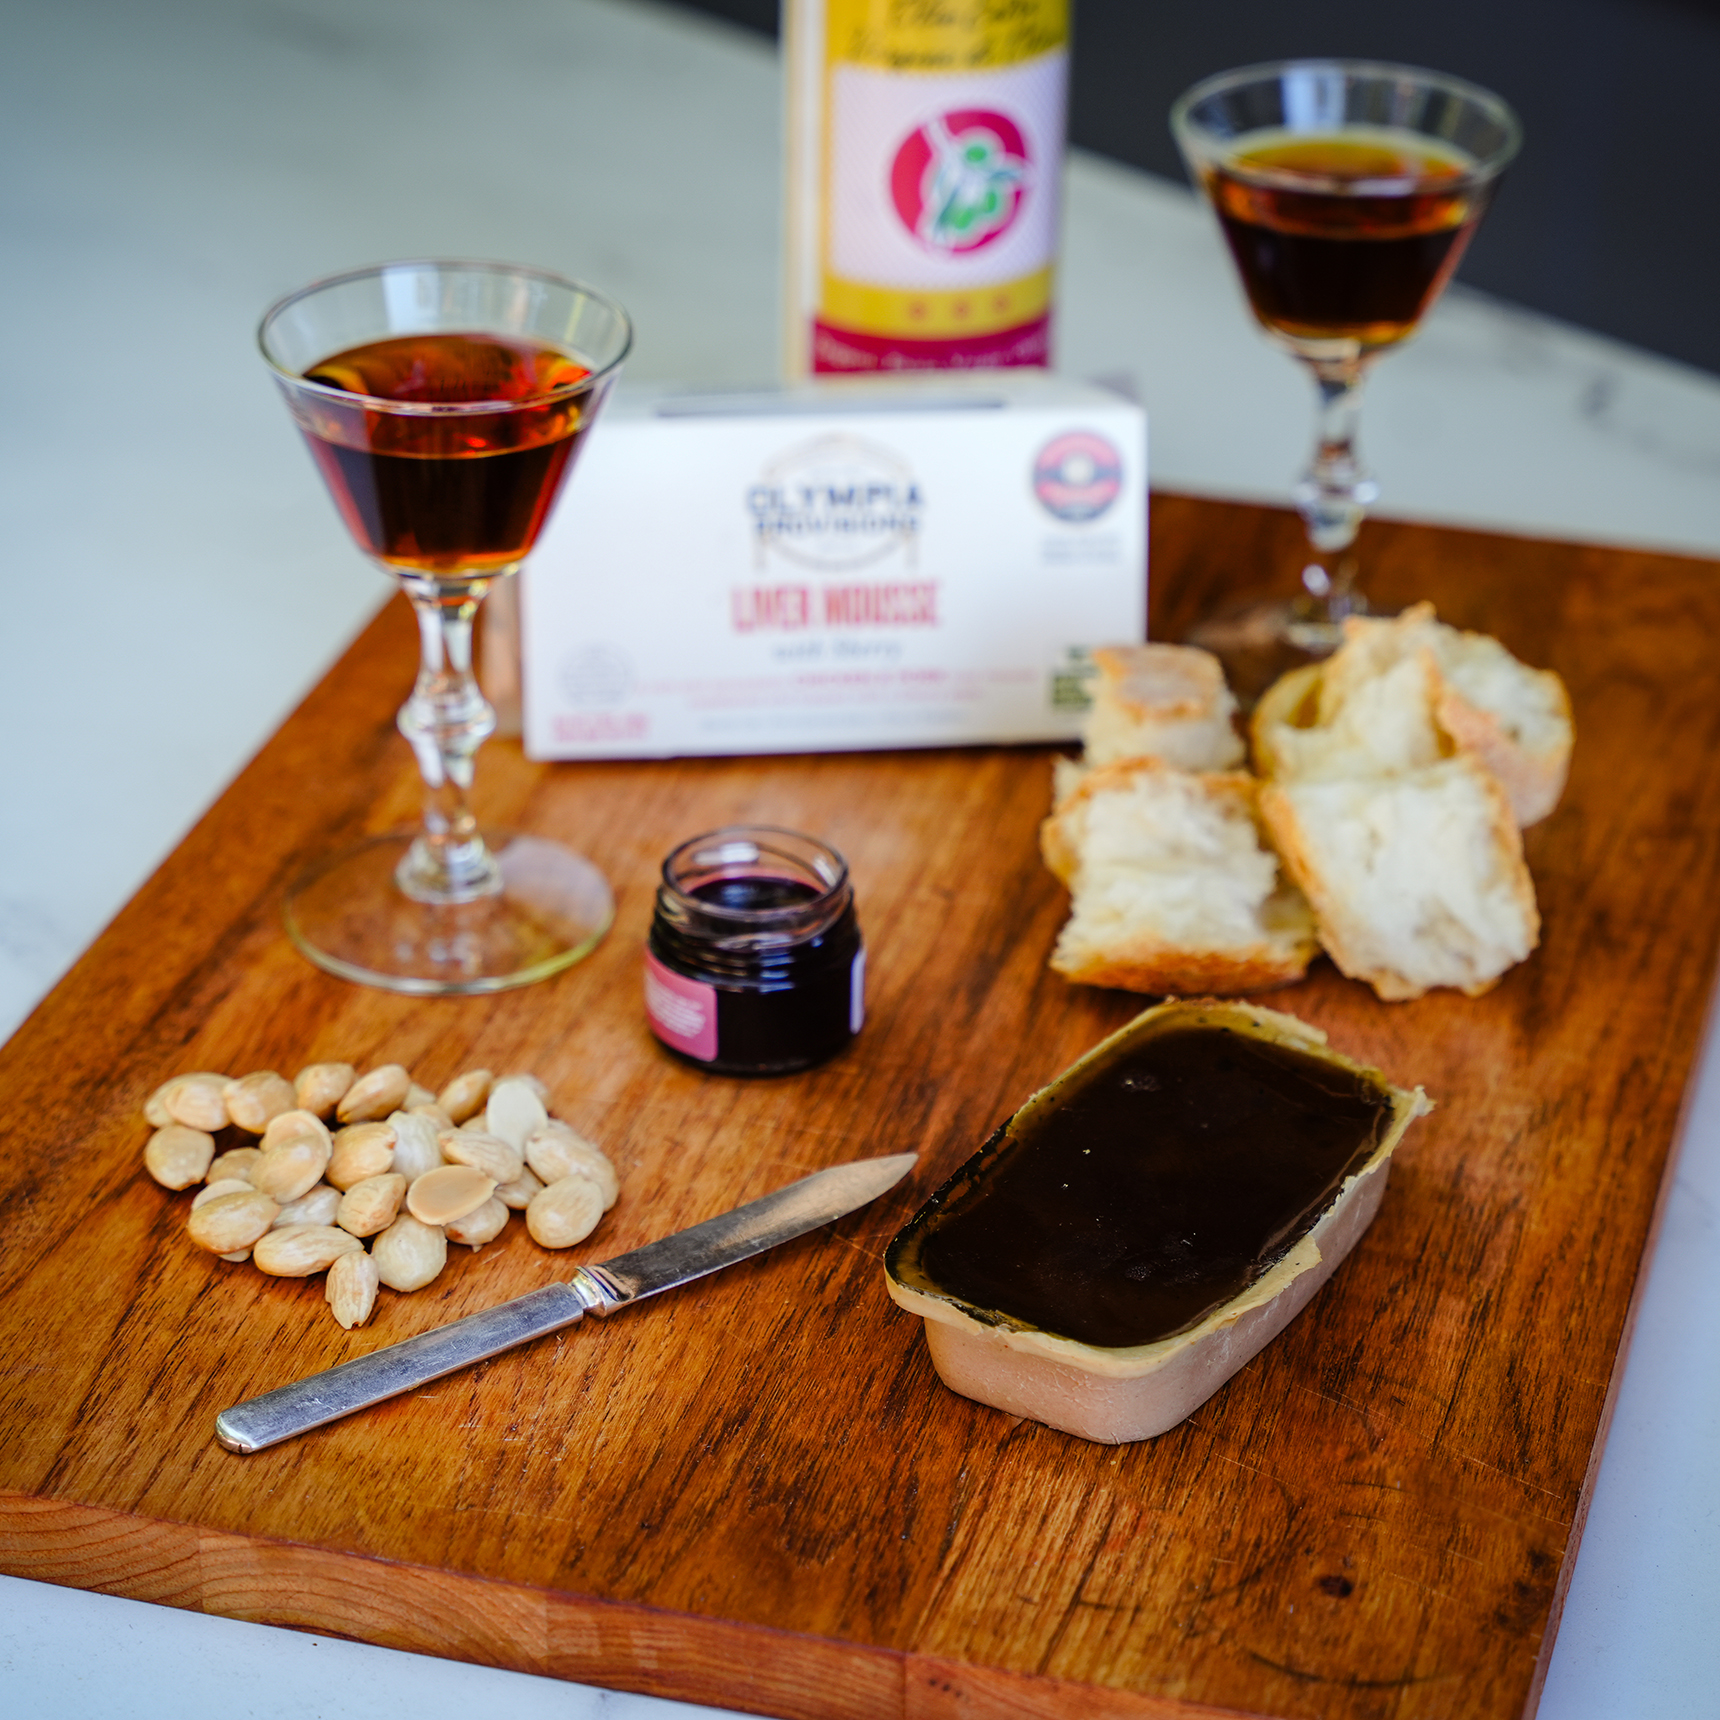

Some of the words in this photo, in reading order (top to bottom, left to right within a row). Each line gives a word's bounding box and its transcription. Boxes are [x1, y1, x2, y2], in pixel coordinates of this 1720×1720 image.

[747, 484, 925, 516] OLYMPIA
[732, 583, 810, 633] LIVER
[824, 577, 941, 628] MOUSSE
